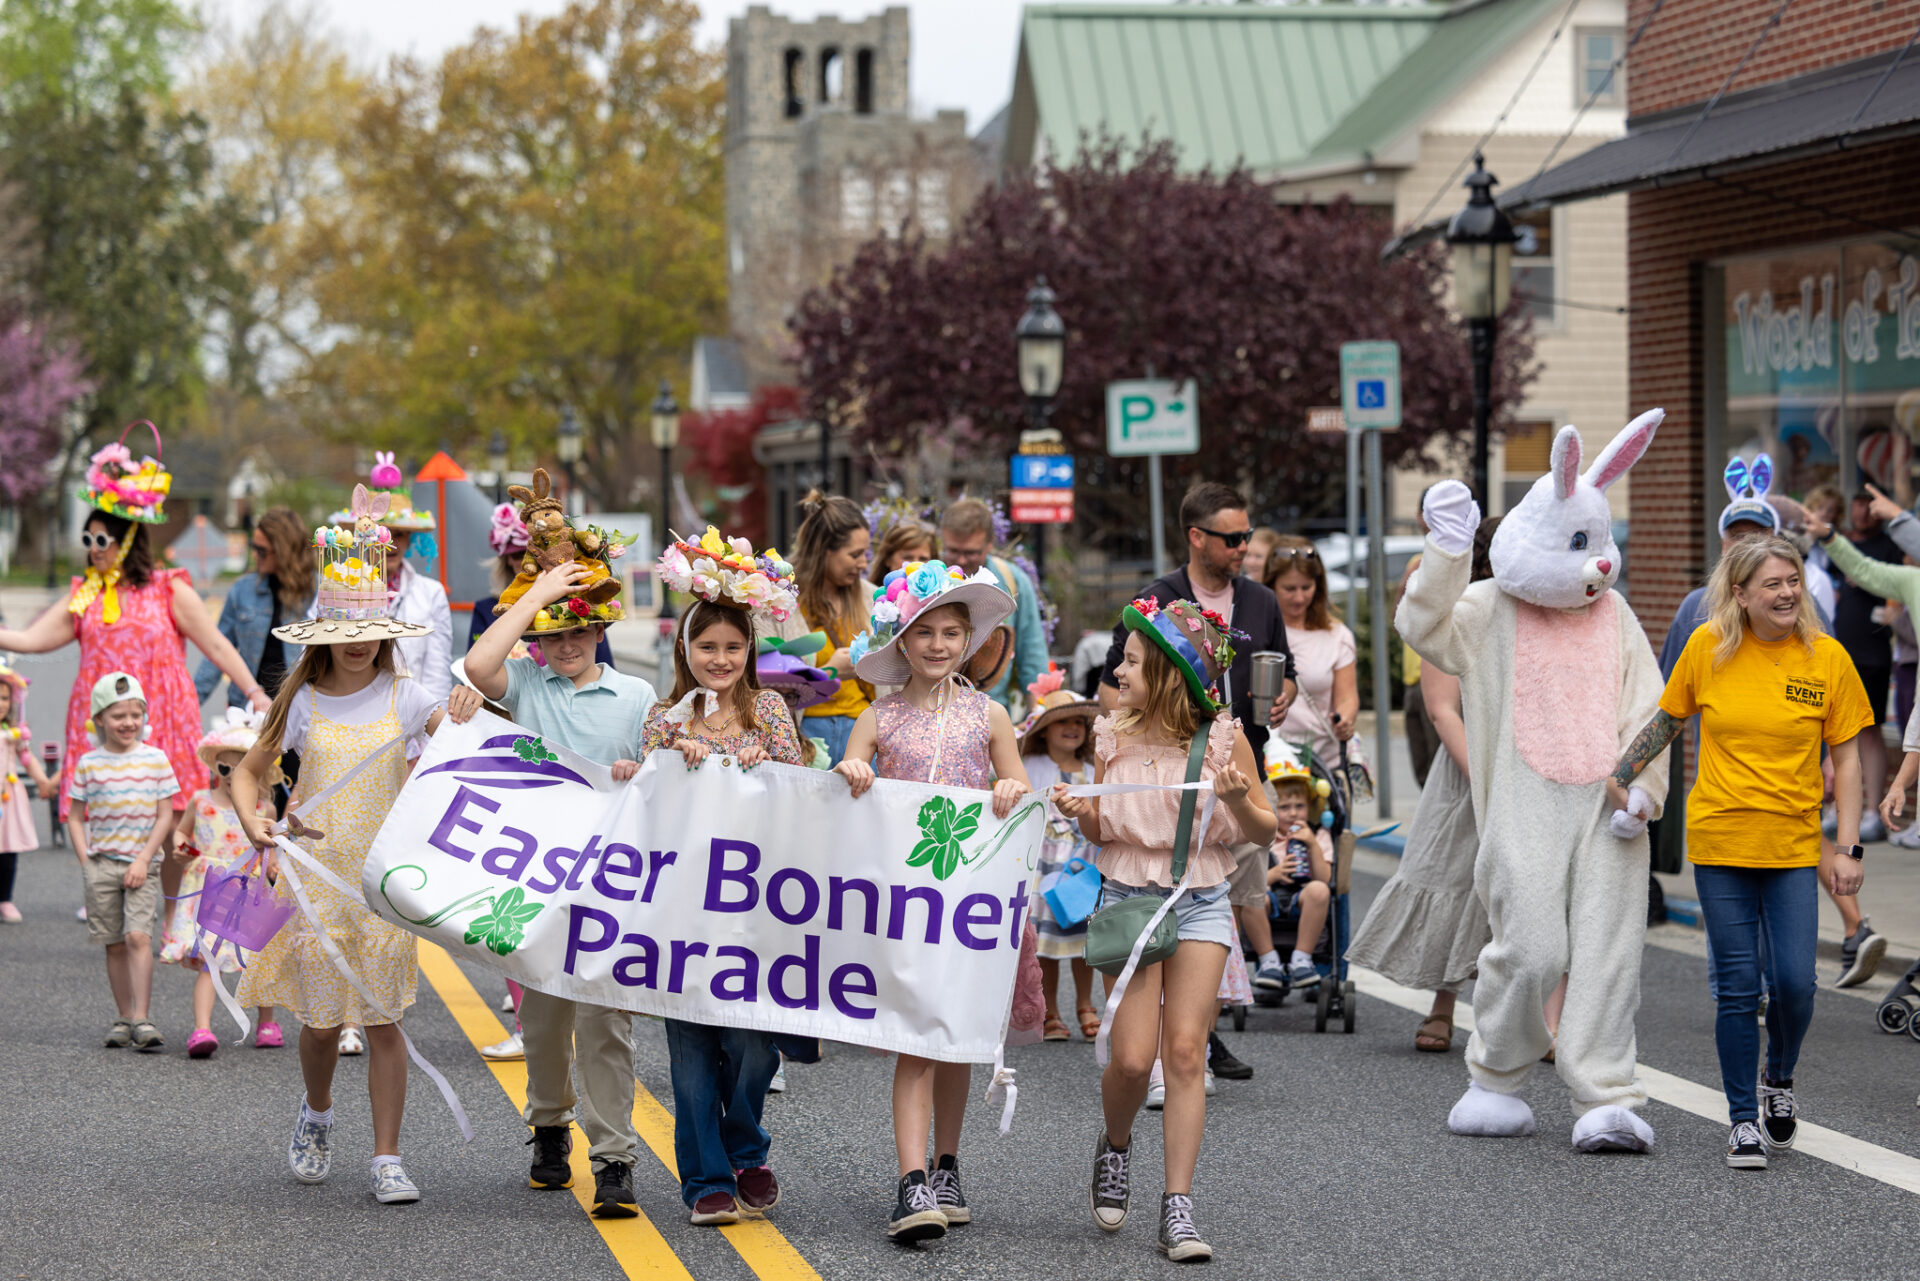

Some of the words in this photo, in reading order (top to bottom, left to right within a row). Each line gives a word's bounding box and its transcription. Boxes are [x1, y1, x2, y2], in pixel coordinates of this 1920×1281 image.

[1734, 274, 1834, 376] World
[1844, 267, 1881, 364] of
[1121, 396, 1155, 440] P
[1029, 461, 1047, 482] P
[1785, 694, 1823, 707] VOLUNTEER
[1786, 684, 1825, 701] EVENT
[427, 784, 678, 904] Easter
[703, 837, 1029, 950] Bonnet
[563, 903, 878, 1020] Parade
